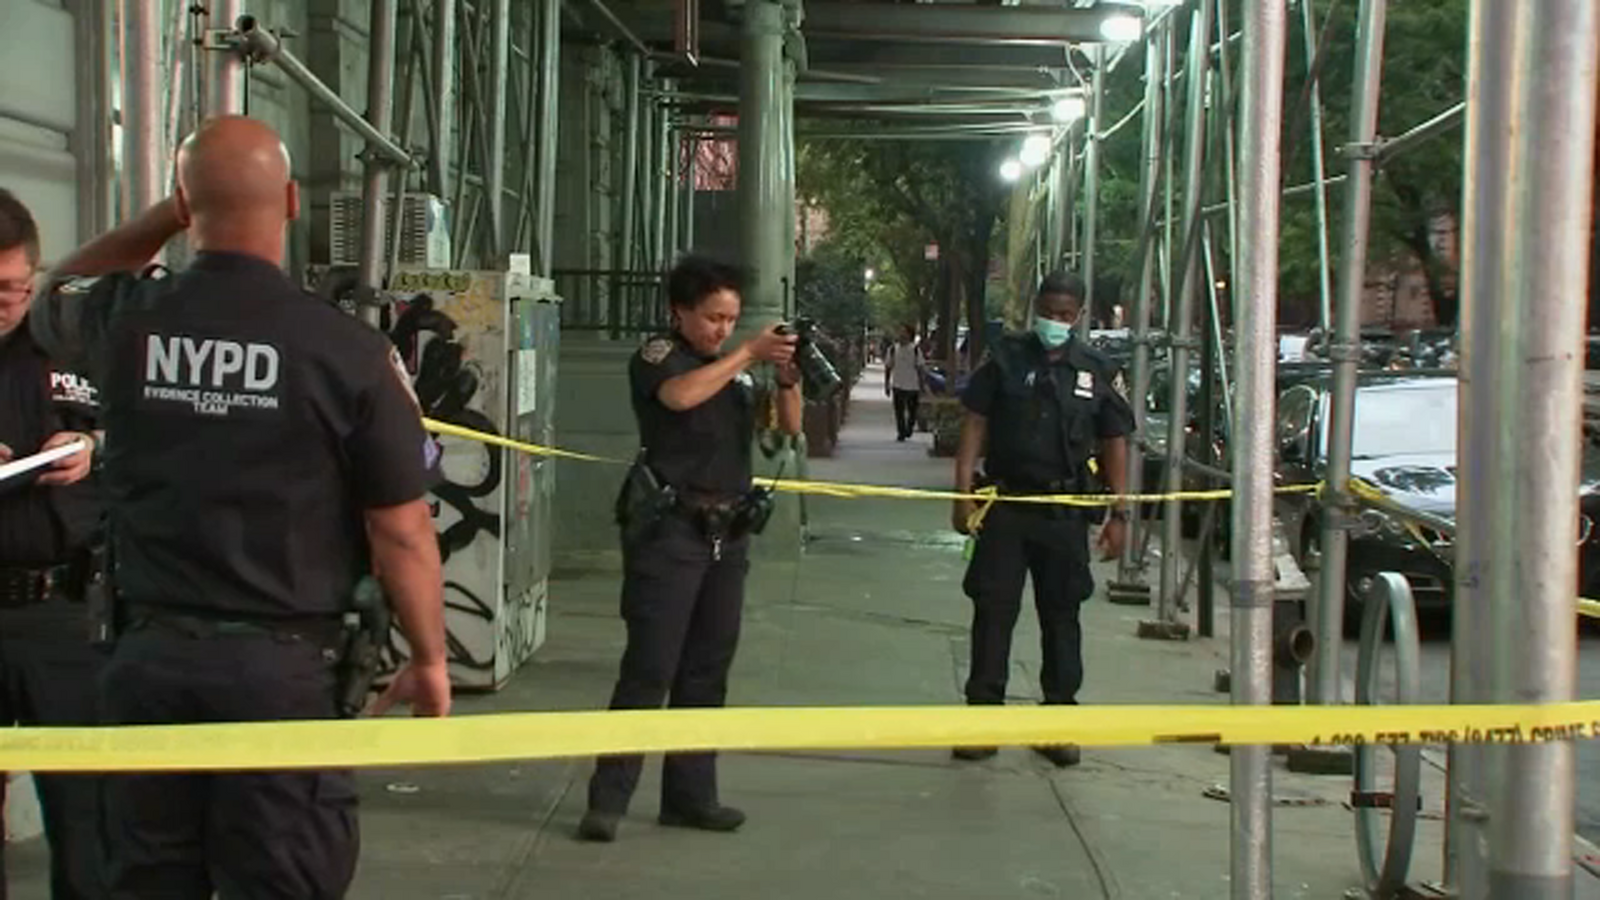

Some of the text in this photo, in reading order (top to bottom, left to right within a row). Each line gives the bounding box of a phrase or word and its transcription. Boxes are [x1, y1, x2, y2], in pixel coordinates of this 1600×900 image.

[146, 334, 279, 391] NYPD
[144, 386, 278, 409] EVIDENCE COLLECTION
[194, 402, 229, 415] TEAM
